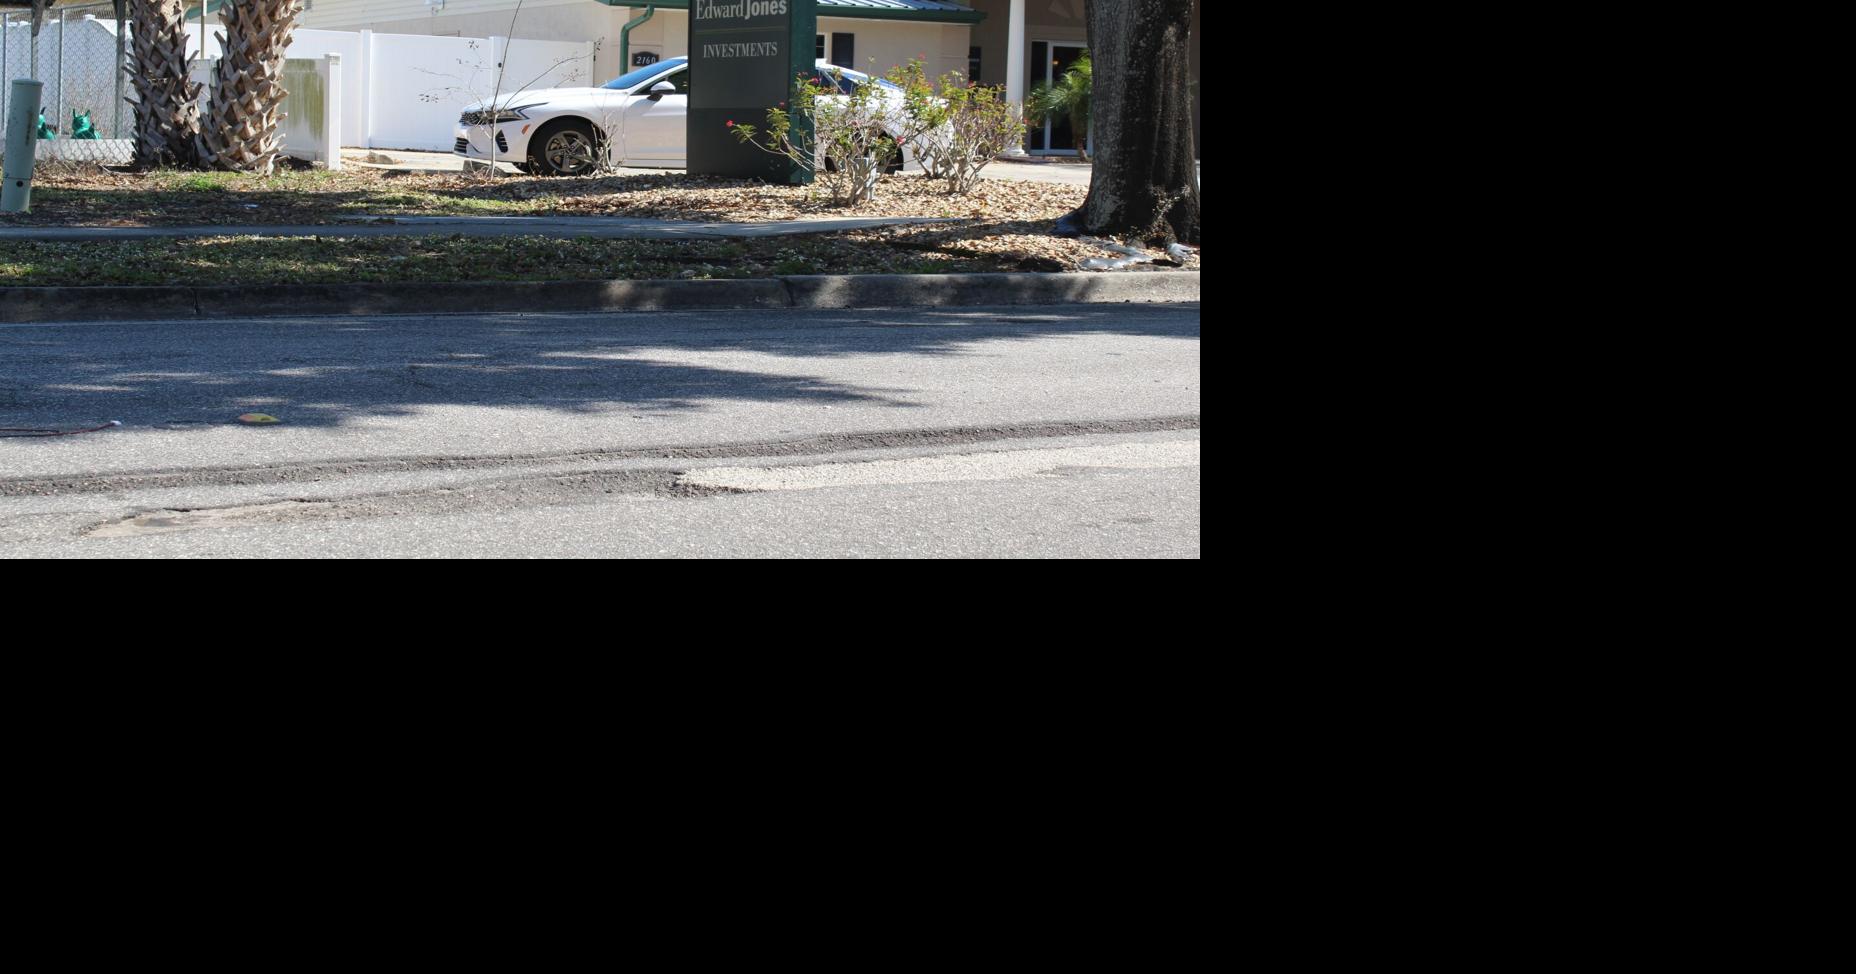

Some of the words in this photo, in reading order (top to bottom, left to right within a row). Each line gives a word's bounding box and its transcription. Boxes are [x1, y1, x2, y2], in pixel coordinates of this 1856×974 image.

[696, 0, 743, 19] Edward
[744, 0, 787, 20] Jones
[703, 42, 777, 58] INVESTMENTS
